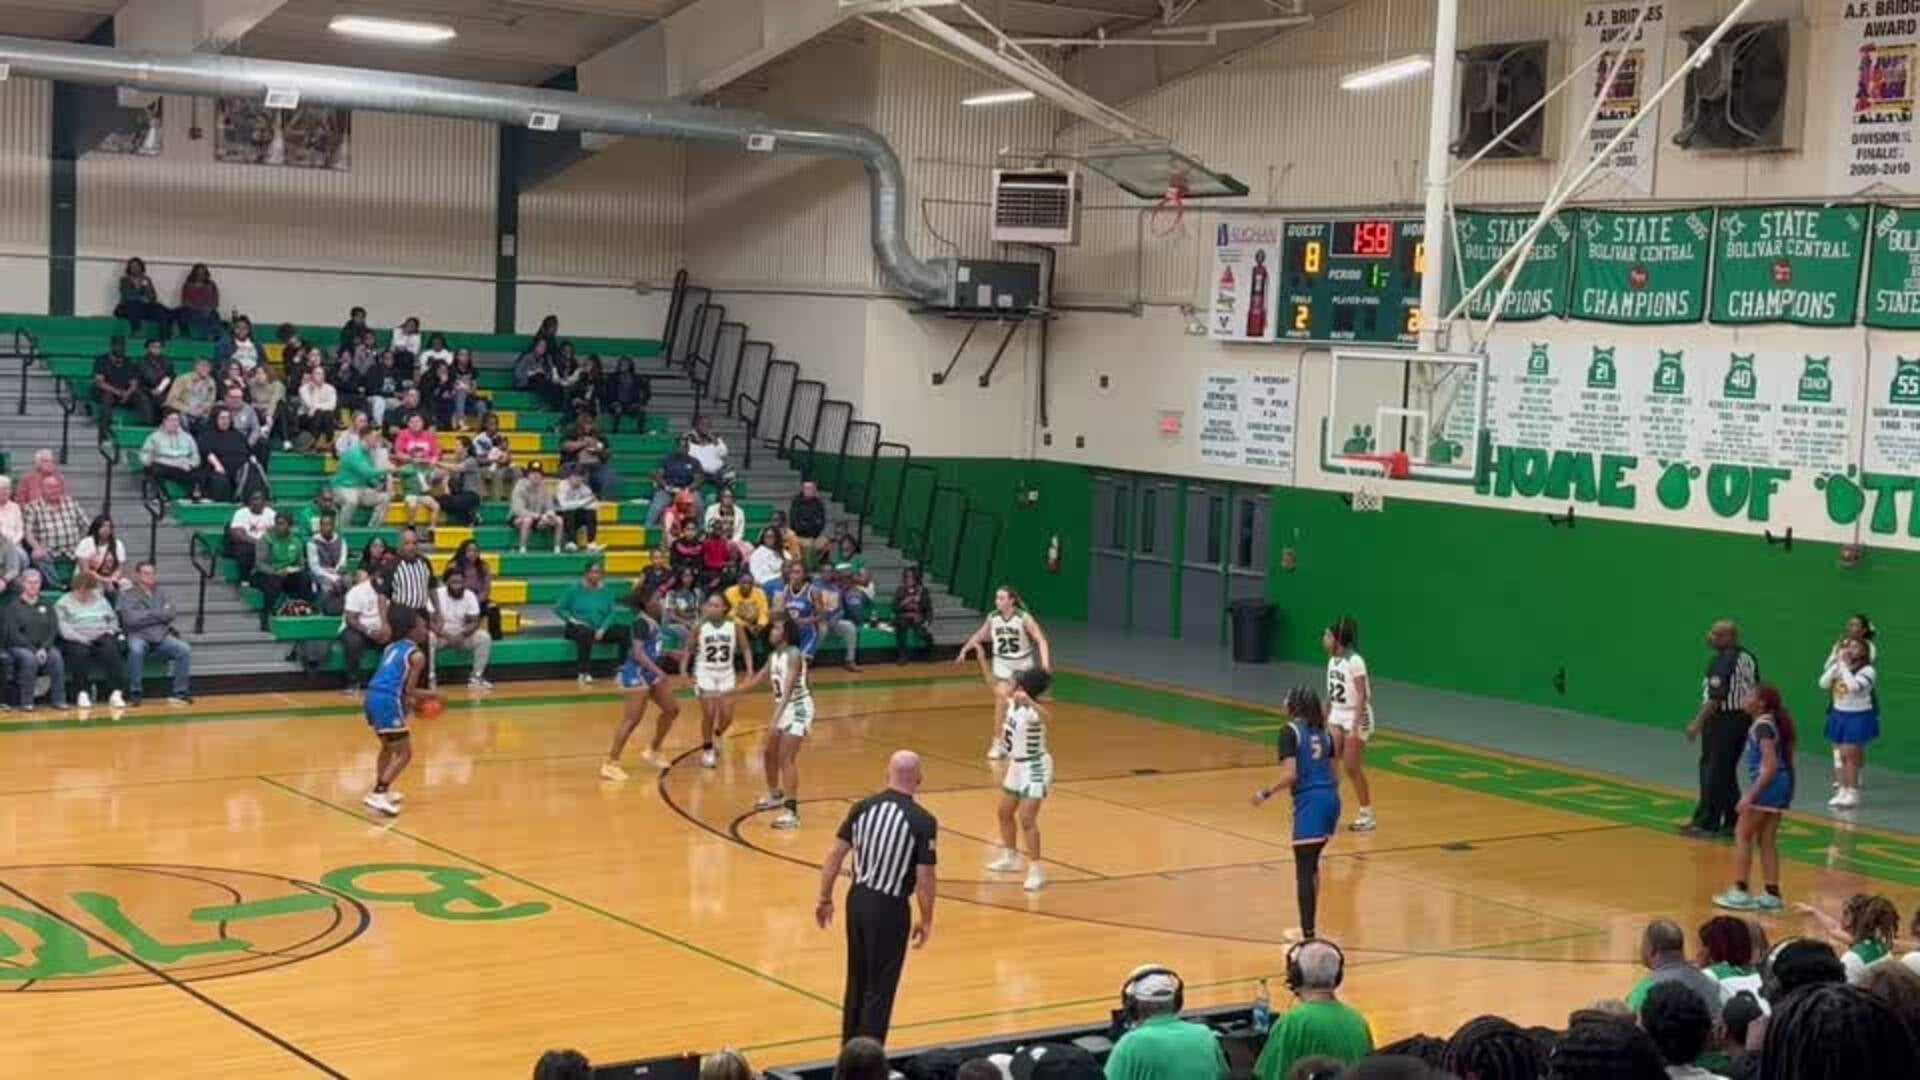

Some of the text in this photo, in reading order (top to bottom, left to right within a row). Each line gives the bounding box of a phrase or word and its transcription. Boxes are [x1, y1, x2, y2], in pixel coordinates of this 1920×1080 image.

[1845, 3, 1871, 19] A.F.
[1864, 19, 1917, 38] AWARD
[1287, 224, 1325, 238] GUEST
[1613, 217, 1674, 244] STATE
[1760, 210, 1820, 239] STATE
[1305, 242, 1321, 273] 8
[1588, 242, 1696, 262] BOLIVAR CENTRAL
[1726, 239, 1851, 259] BOLIVAR CENTRAL
[1328, 269, 1362, 280] PERIOD
[1582, 287, 1691, 318] CHAMPIONS
[1728, 288, 1837, 319] CHAMPIONS
[1295, 305, 1310, 329] 2
[1595, 362, 1609, 380] 21
[1662, 367, 1677, 386] 21
[1731, 370, 1751, 388] 40
[1897, 375, 1919, 395] 55
[1475, 446, 1638, 510] HOME
[1707, 464, 1792, 522] OF
[706, 645, 730, 662] 23
[998, 638, 1020, 654] 25
[1329, 683, 1346, 703] 22
[1311, 735, 1323, 759] 5
